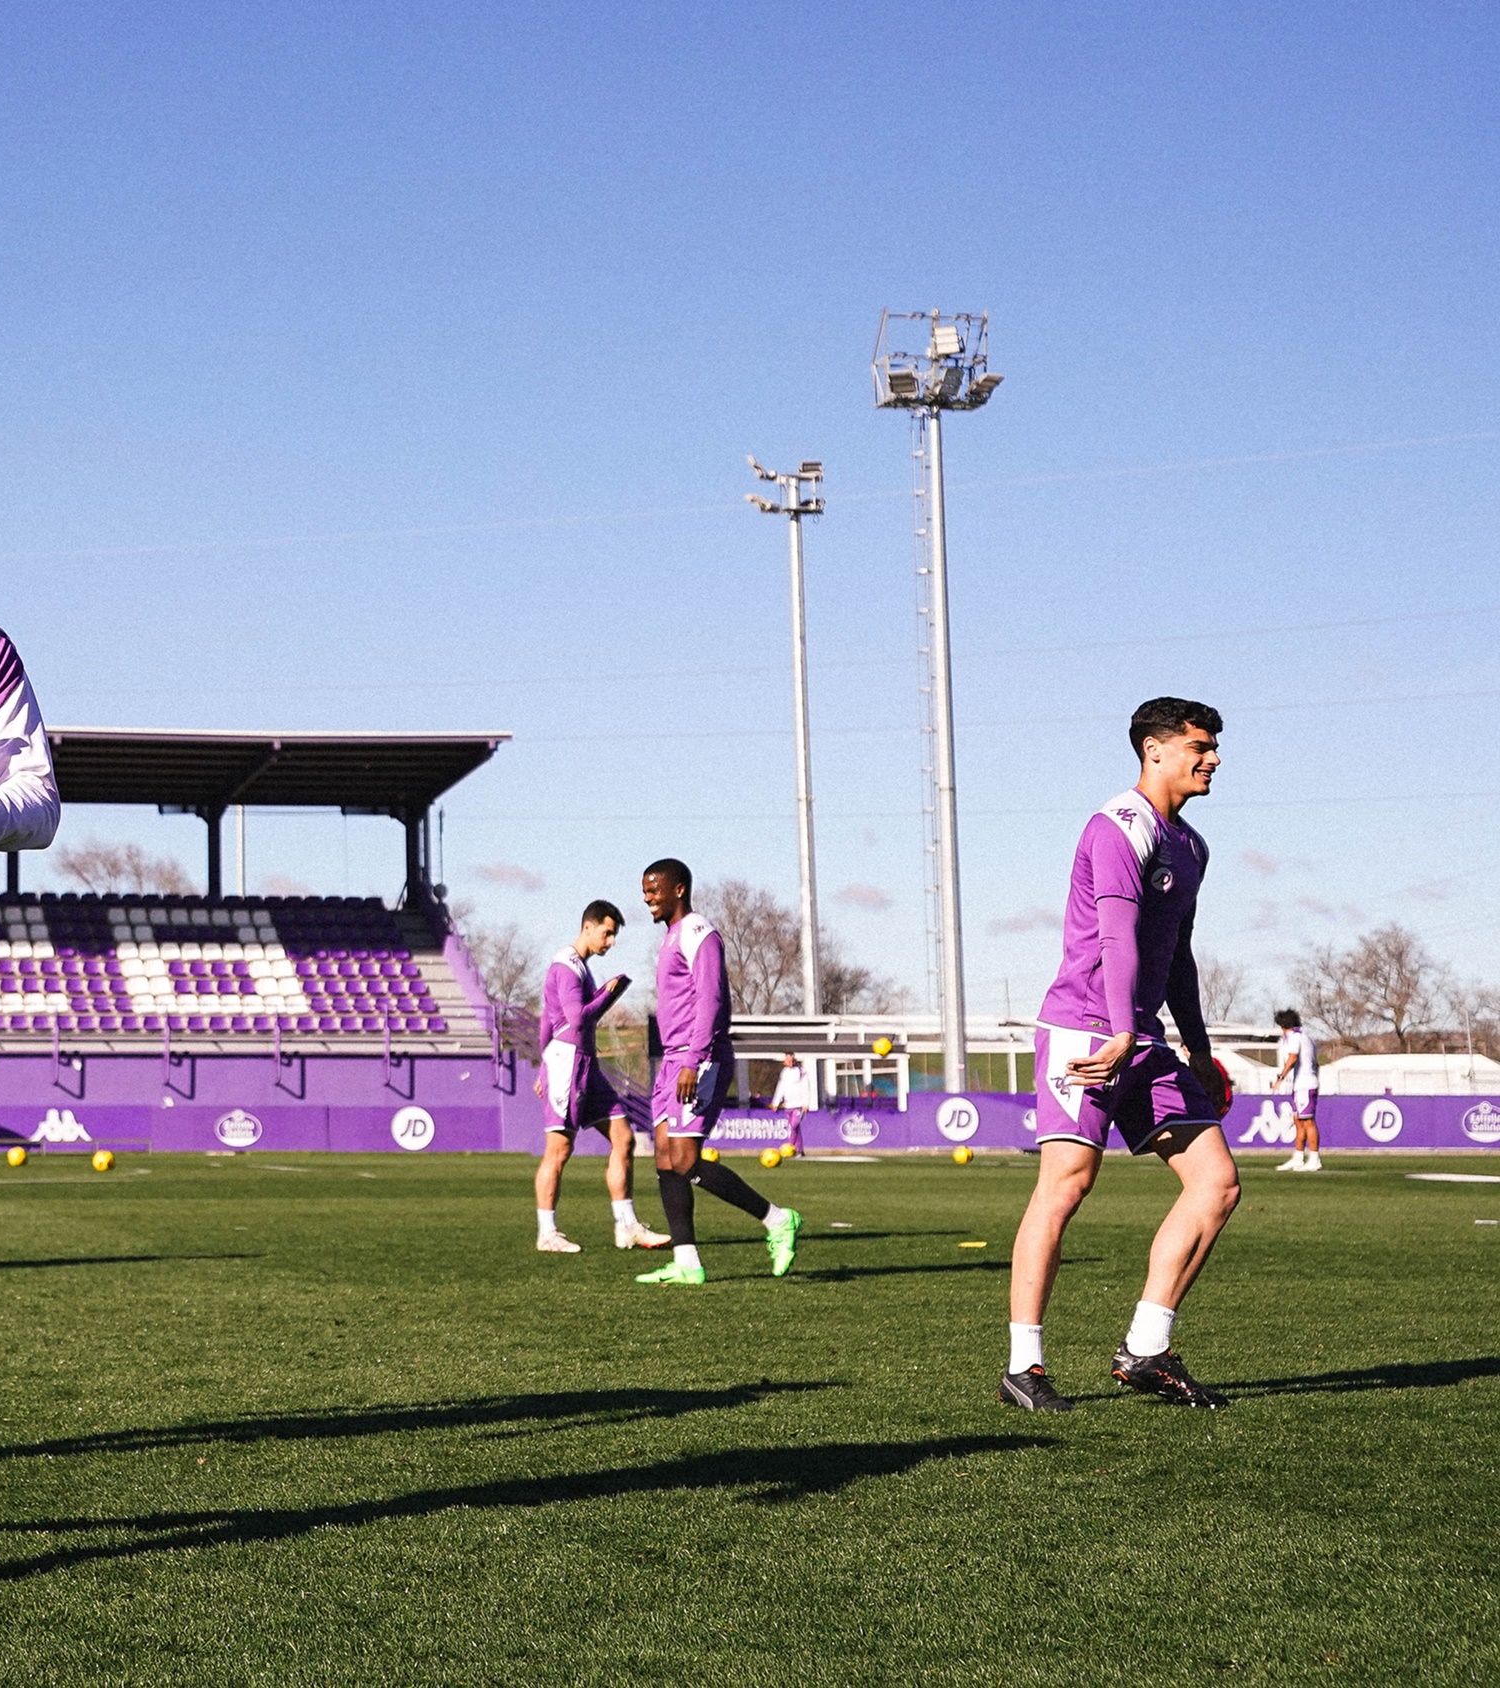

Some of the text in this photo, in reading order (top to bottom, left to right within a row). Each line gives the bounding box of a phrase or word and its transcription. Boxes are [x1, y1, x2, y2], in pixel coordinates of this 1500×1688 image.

[400, 1119, 427, 1137] JD
[725, 1118, 789, 1129] HERBALIF
[945, 1110, 971, 1128] JD
[1370, 1111, 1395, 1129] JD
